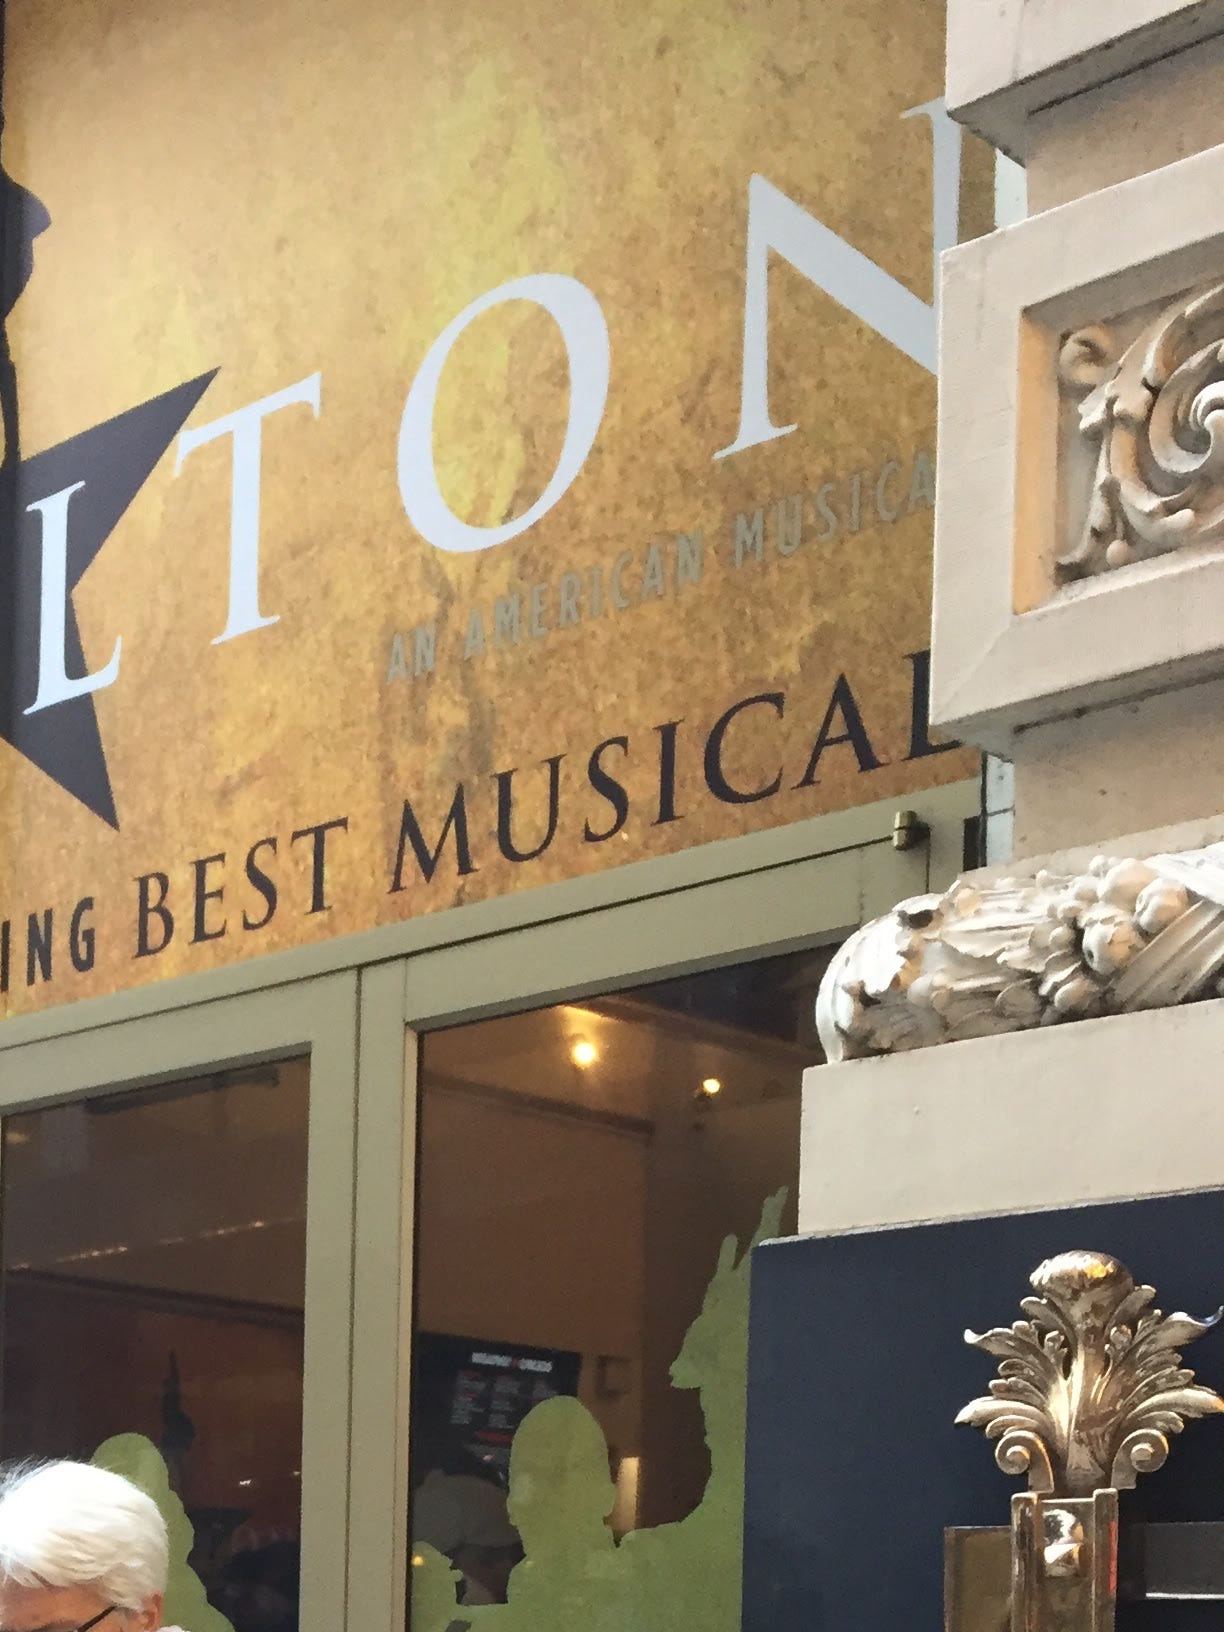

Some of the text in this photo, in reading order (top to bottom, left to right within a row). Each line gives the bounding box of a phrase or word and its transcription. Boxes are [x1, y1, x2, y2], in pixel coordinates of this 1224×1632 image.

[385, 453, 938, 686] AN AMERICAN MUSICA
[130, 816, 350, 960] BEST
[386, 648, 964, 895] MUSICAL
